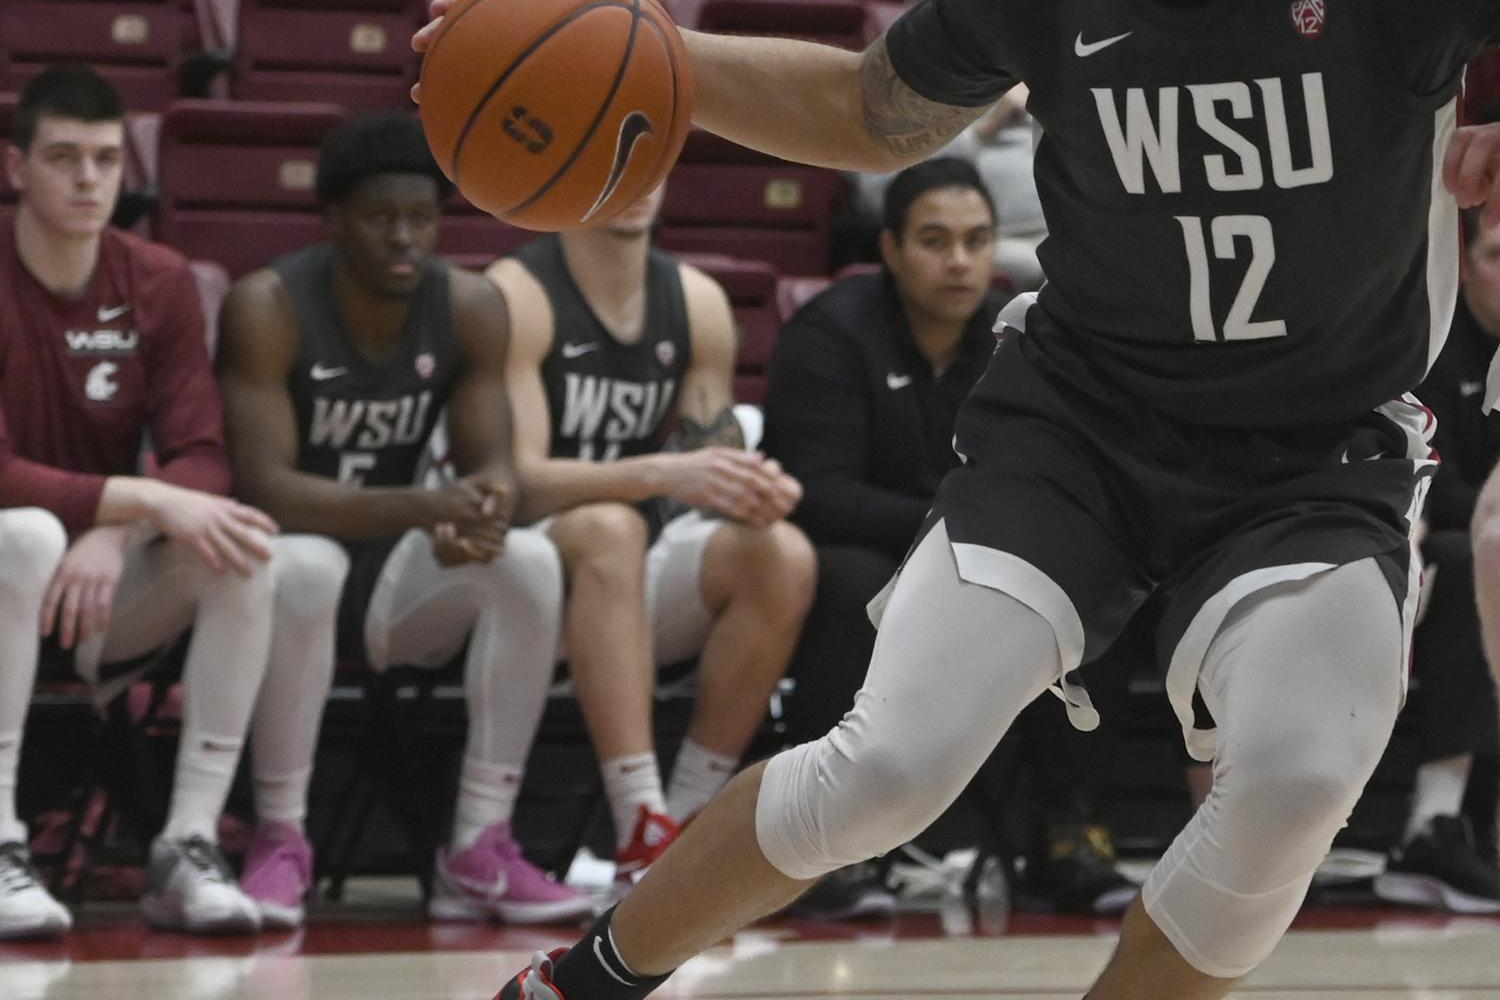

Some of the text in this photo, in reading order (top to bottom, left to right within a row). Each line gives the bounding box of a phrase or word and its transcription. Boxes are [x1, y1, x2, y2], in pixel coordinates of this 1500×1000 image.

[1300, 16, 1318, 34] 12
[1090, 72, 1334, 195] WSU
[1172, 214, 1288, 342] 12
[65, 330, 139, 350] WSU
[310, 391, 432, 448] WSU
[561, 373, 675, 439] WSU
